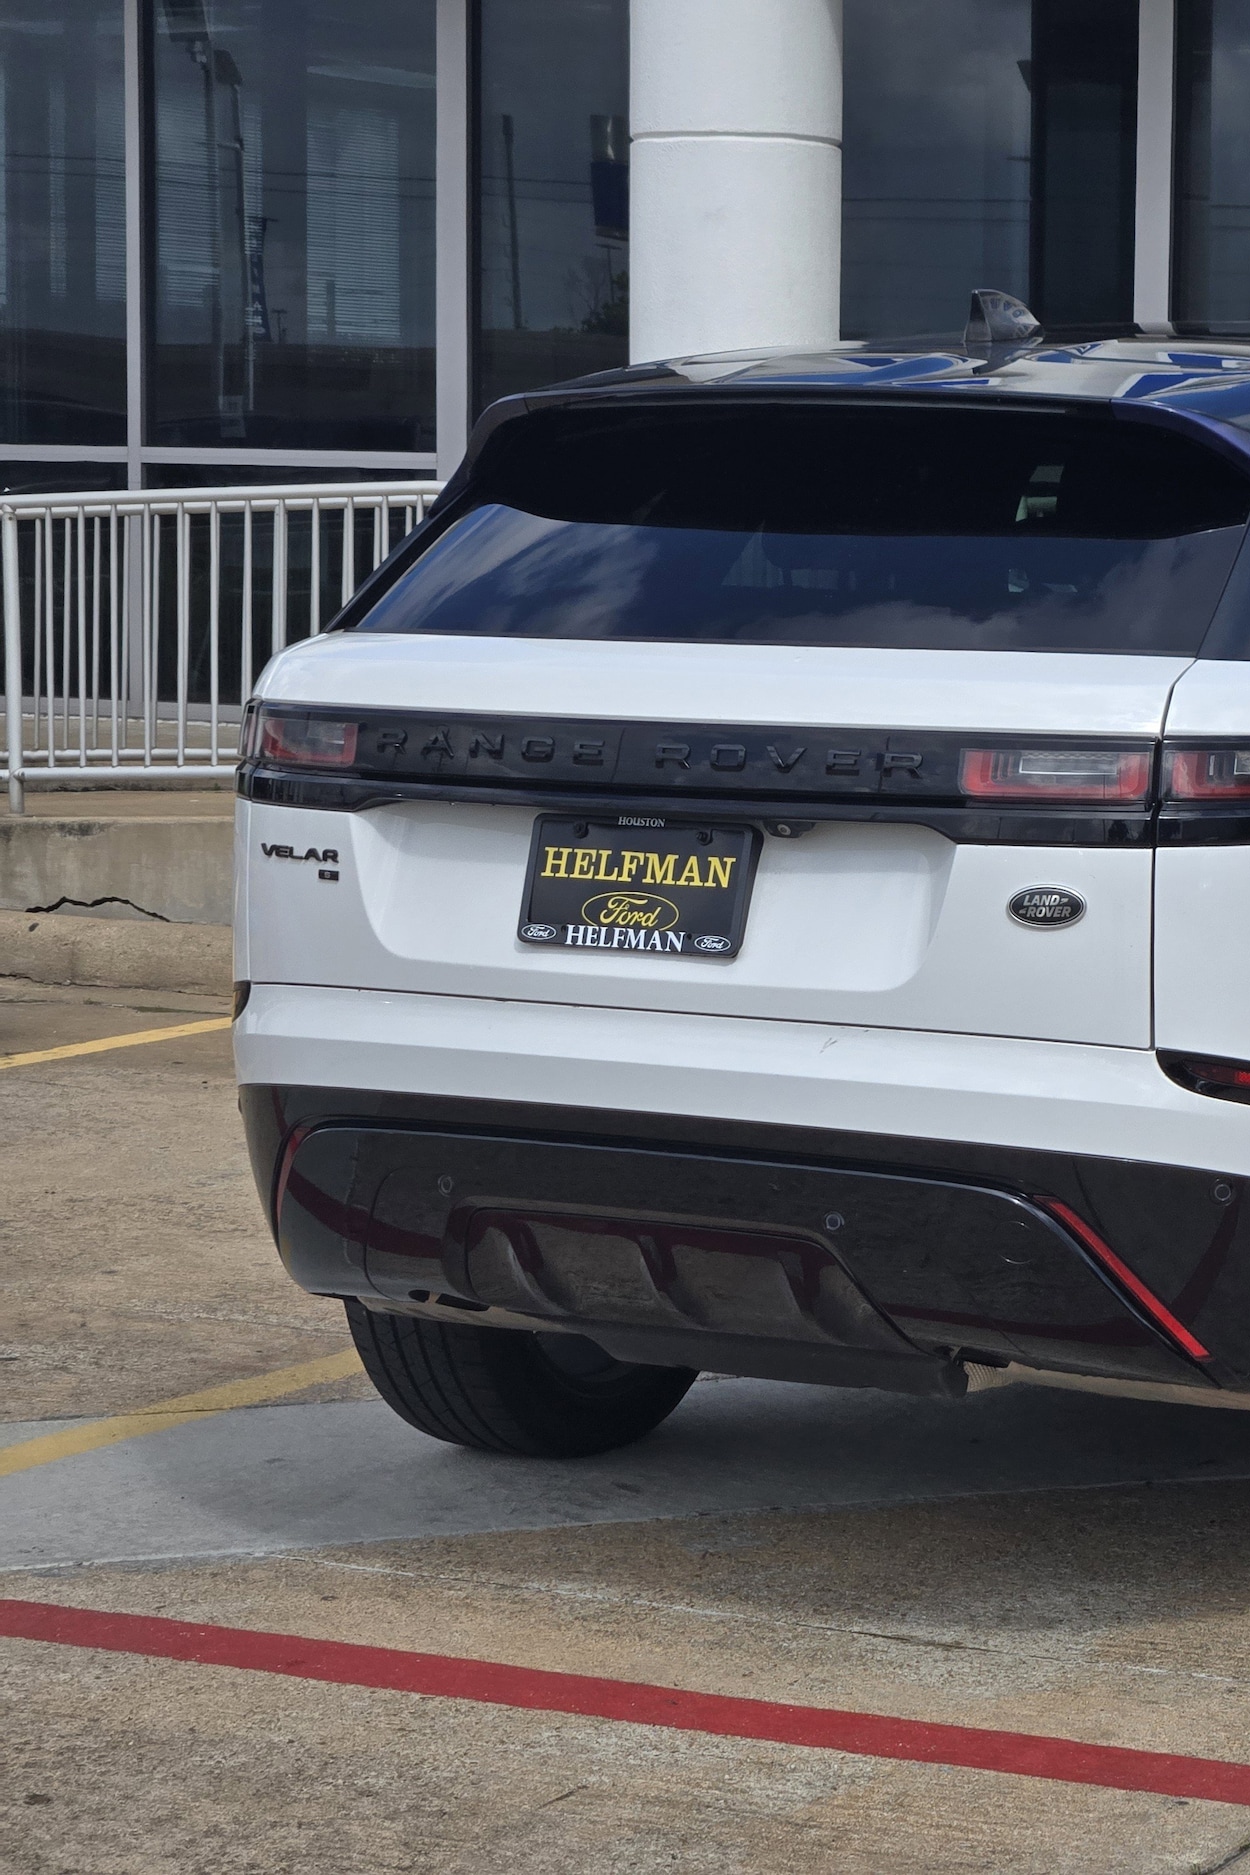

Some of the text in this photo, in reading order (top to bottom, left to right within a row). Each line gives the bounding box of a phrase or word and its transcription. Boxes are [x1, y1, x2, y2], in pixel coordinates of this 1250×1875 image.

[376, 727, 924, 778] RANGE ROVER
[618, 816, 666, 828] HOUSTON
[261, 842, 339, 863] VELAR
[541, 846, 737, 888] HELFMAN
[1023, 894, 1060, 906] LAND
[600, 896, 662, 927] Ford
[1026, 906, 1072, 918] ROVER
[527, 925, 551, 938] Ford
[564, 924, 686, 952] HELFMAN
[700, 936, 726, 950] Ford
